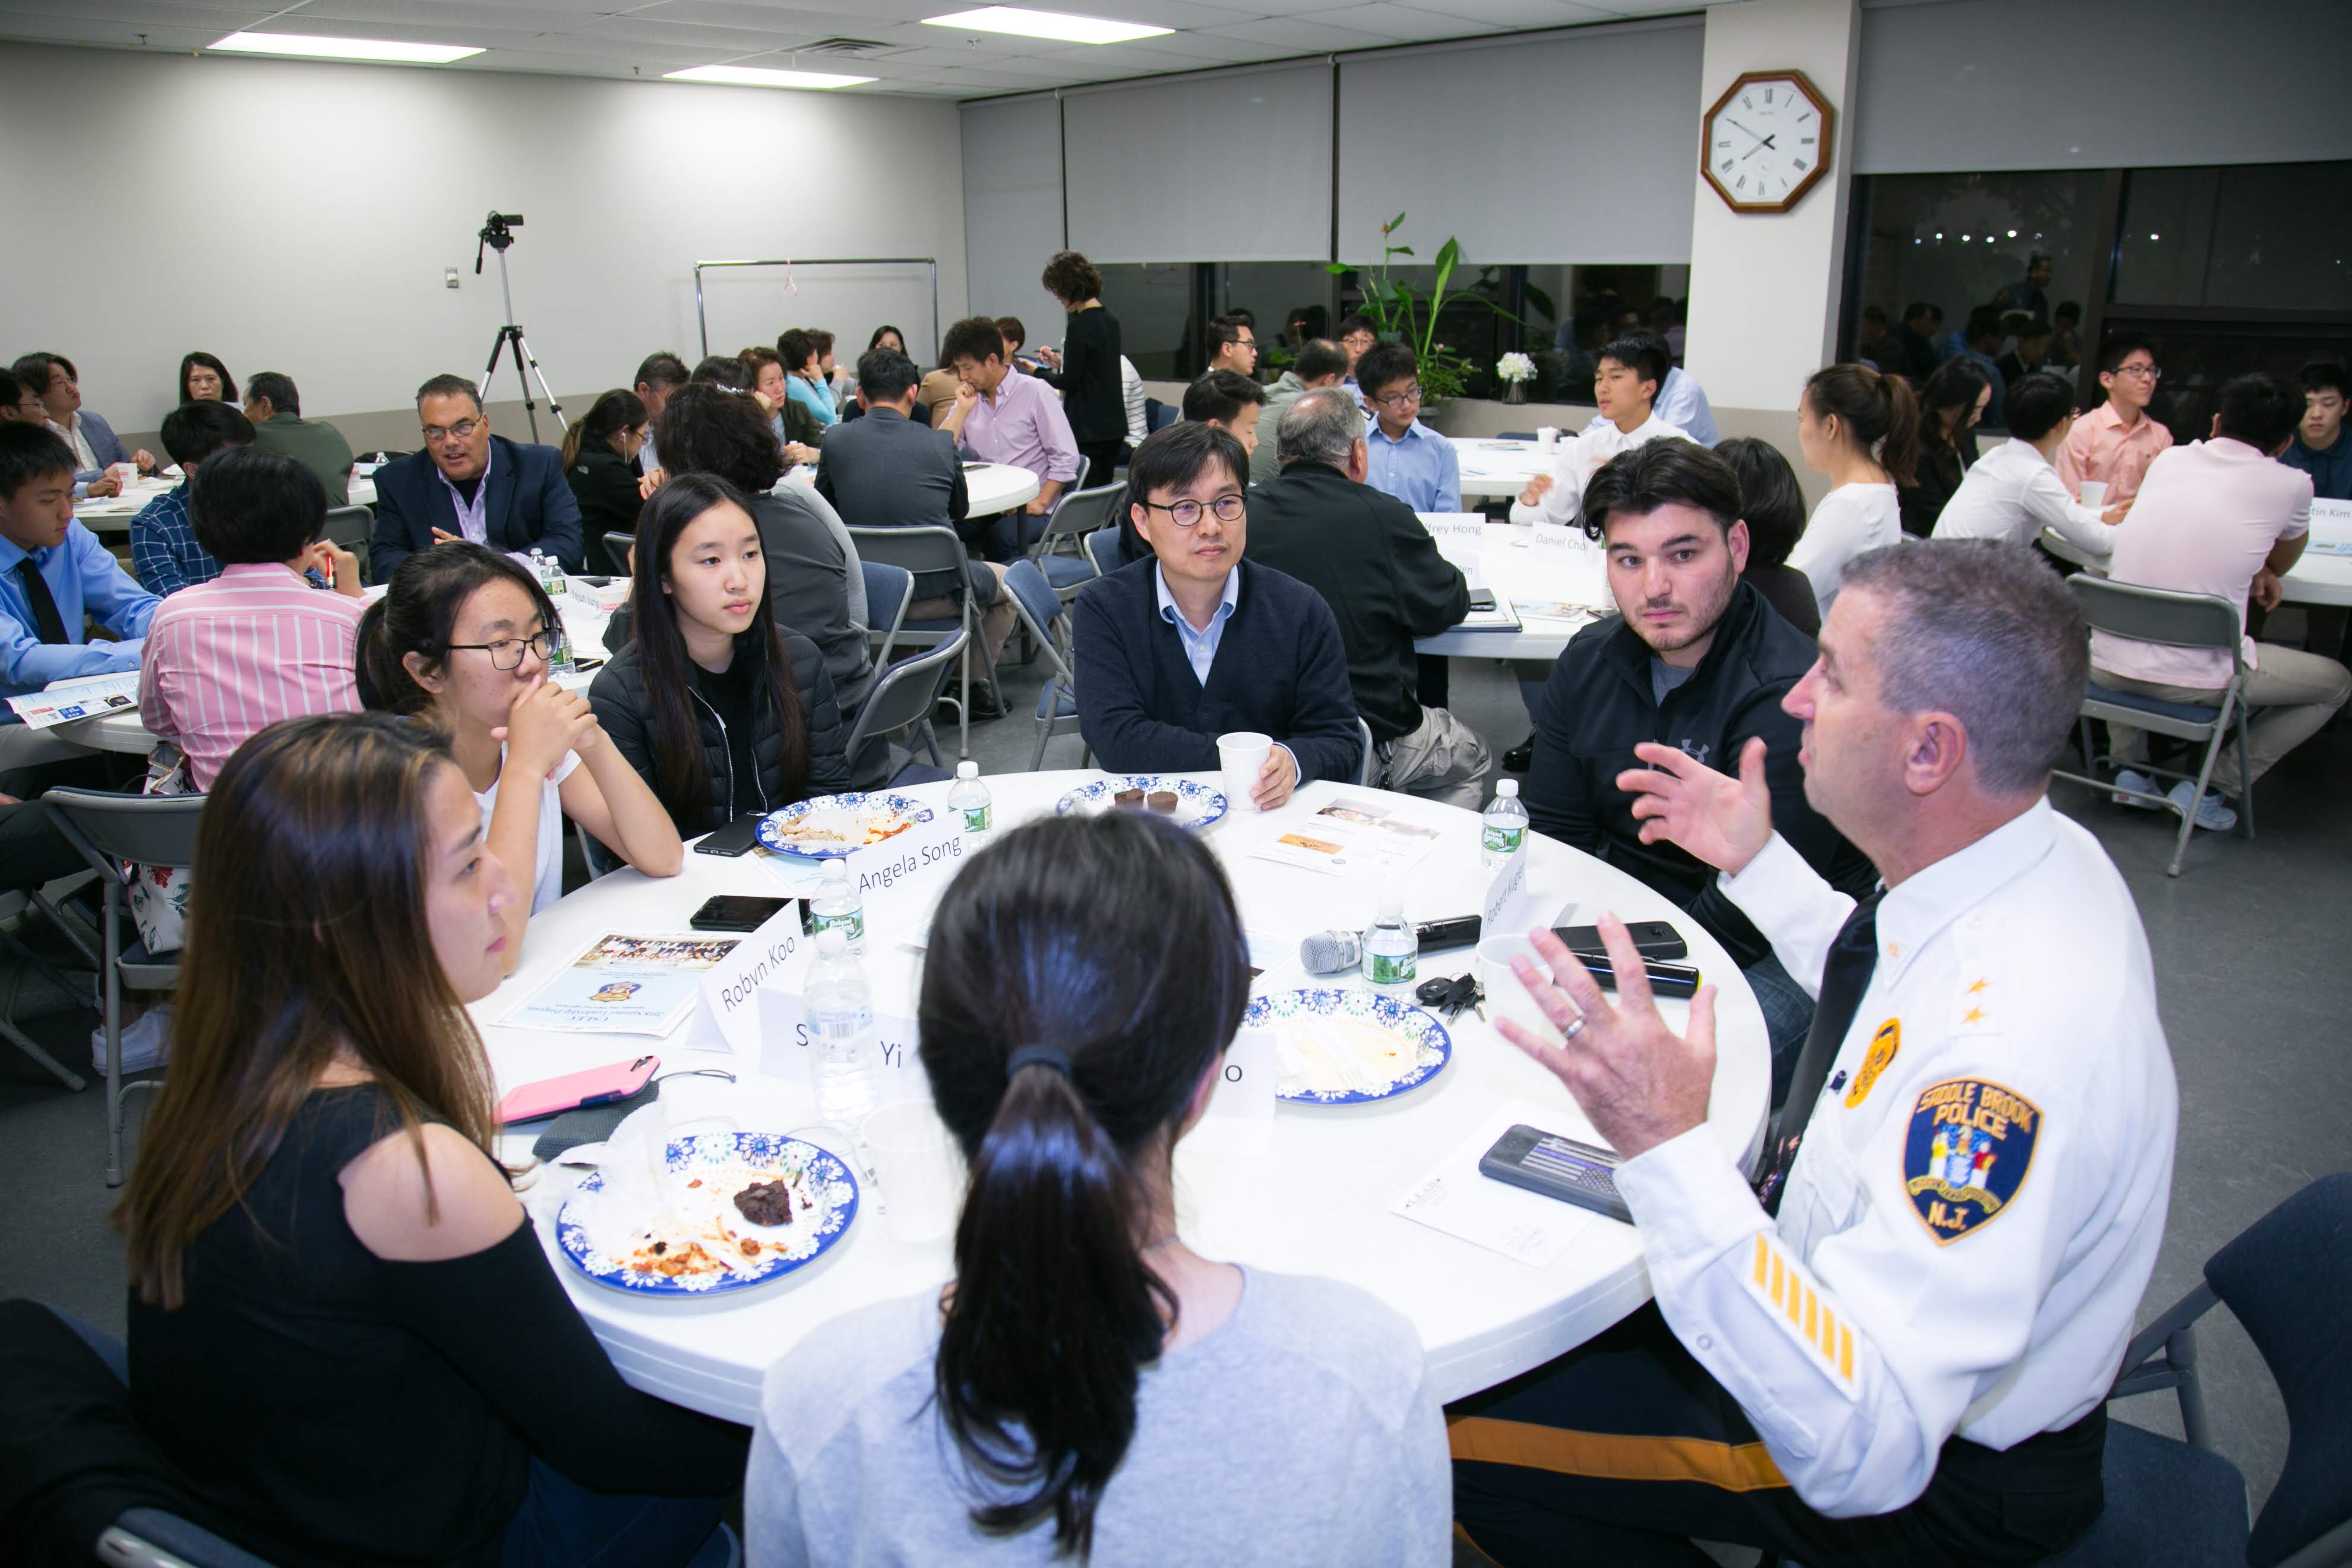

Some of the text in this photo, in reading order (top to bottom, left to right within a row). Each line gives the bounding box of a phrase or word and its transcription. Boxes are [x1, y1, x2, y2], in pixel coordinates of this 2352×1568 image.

[2328, 508, 2350, 518] Kim
[1453, 524, 1482, 536] Hong
[1536, 532, 1566, 547] Daniel
[1484, 832, 1505, 847] Spring
[859, 831, 962, 894] Angela Song
[1487, 888, 1507, 931] Robert
[722, 937, 795, 1012] Robyn Koo
[880, 1041, 901, 1068] Yi
[1916, 1082, 2035, 1134] SADDLE BROOK
[1933, 1102, 2010, 1141] POLICE
